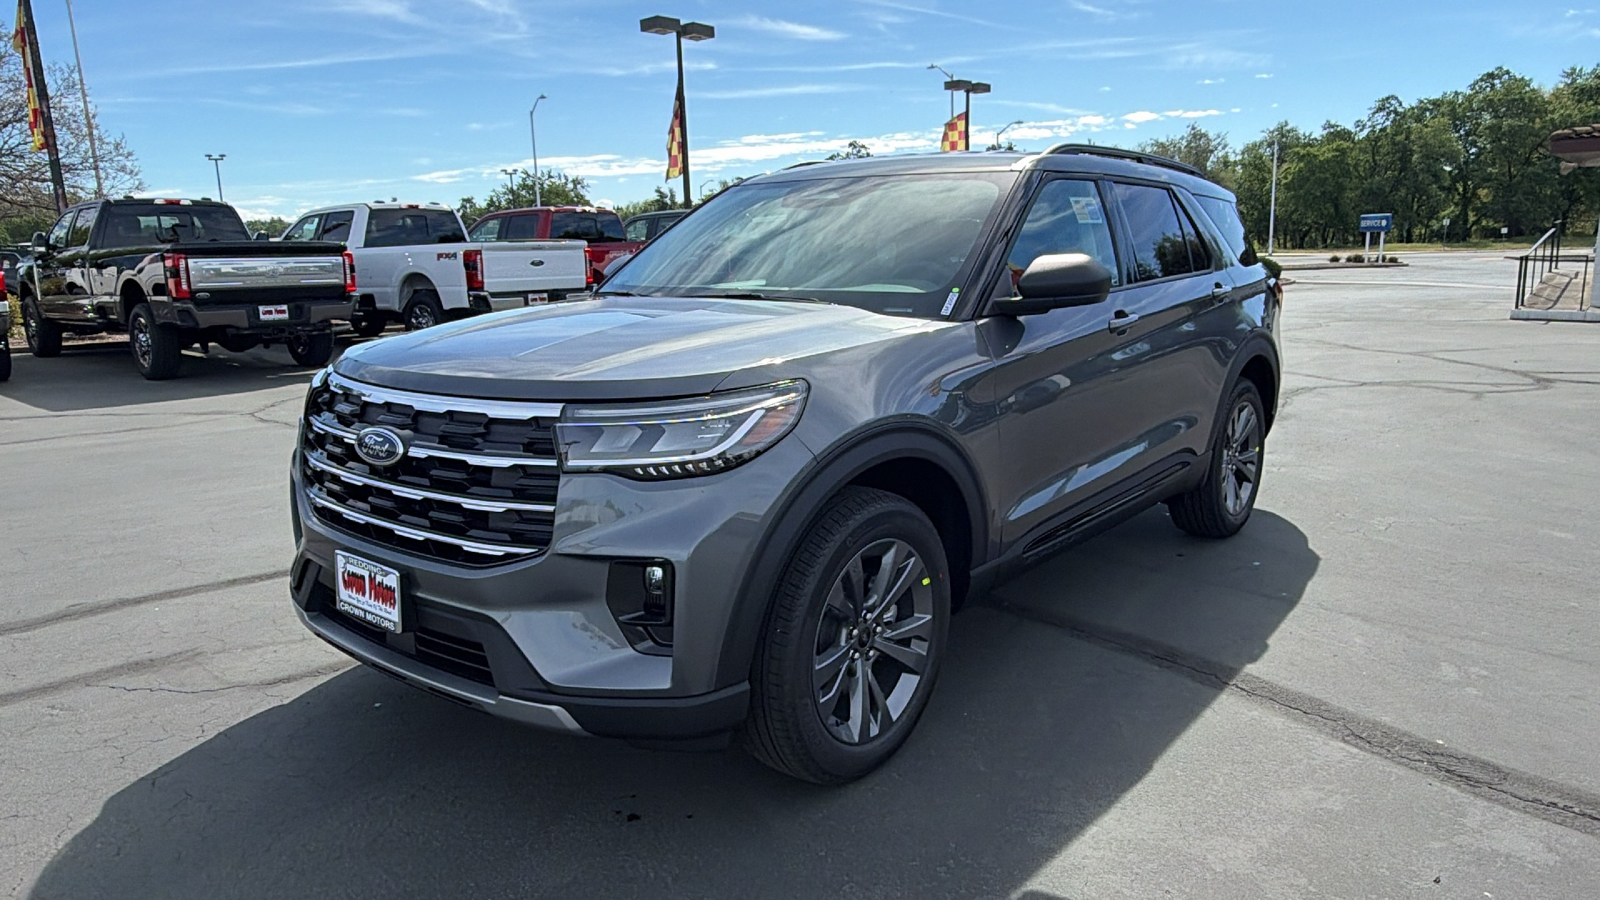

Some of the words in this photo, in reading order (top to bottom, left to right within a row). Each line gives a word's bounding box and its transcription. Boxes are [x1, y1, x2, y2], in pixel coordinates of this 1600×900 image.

[436, 252, 457, 261] FX4
[361, 434, 389, 457] Ford
[348, 557, 382, 574] REDDING
[340, 602, 365, 618] CROWN
[365, 611, 395, 630] MOTORS
